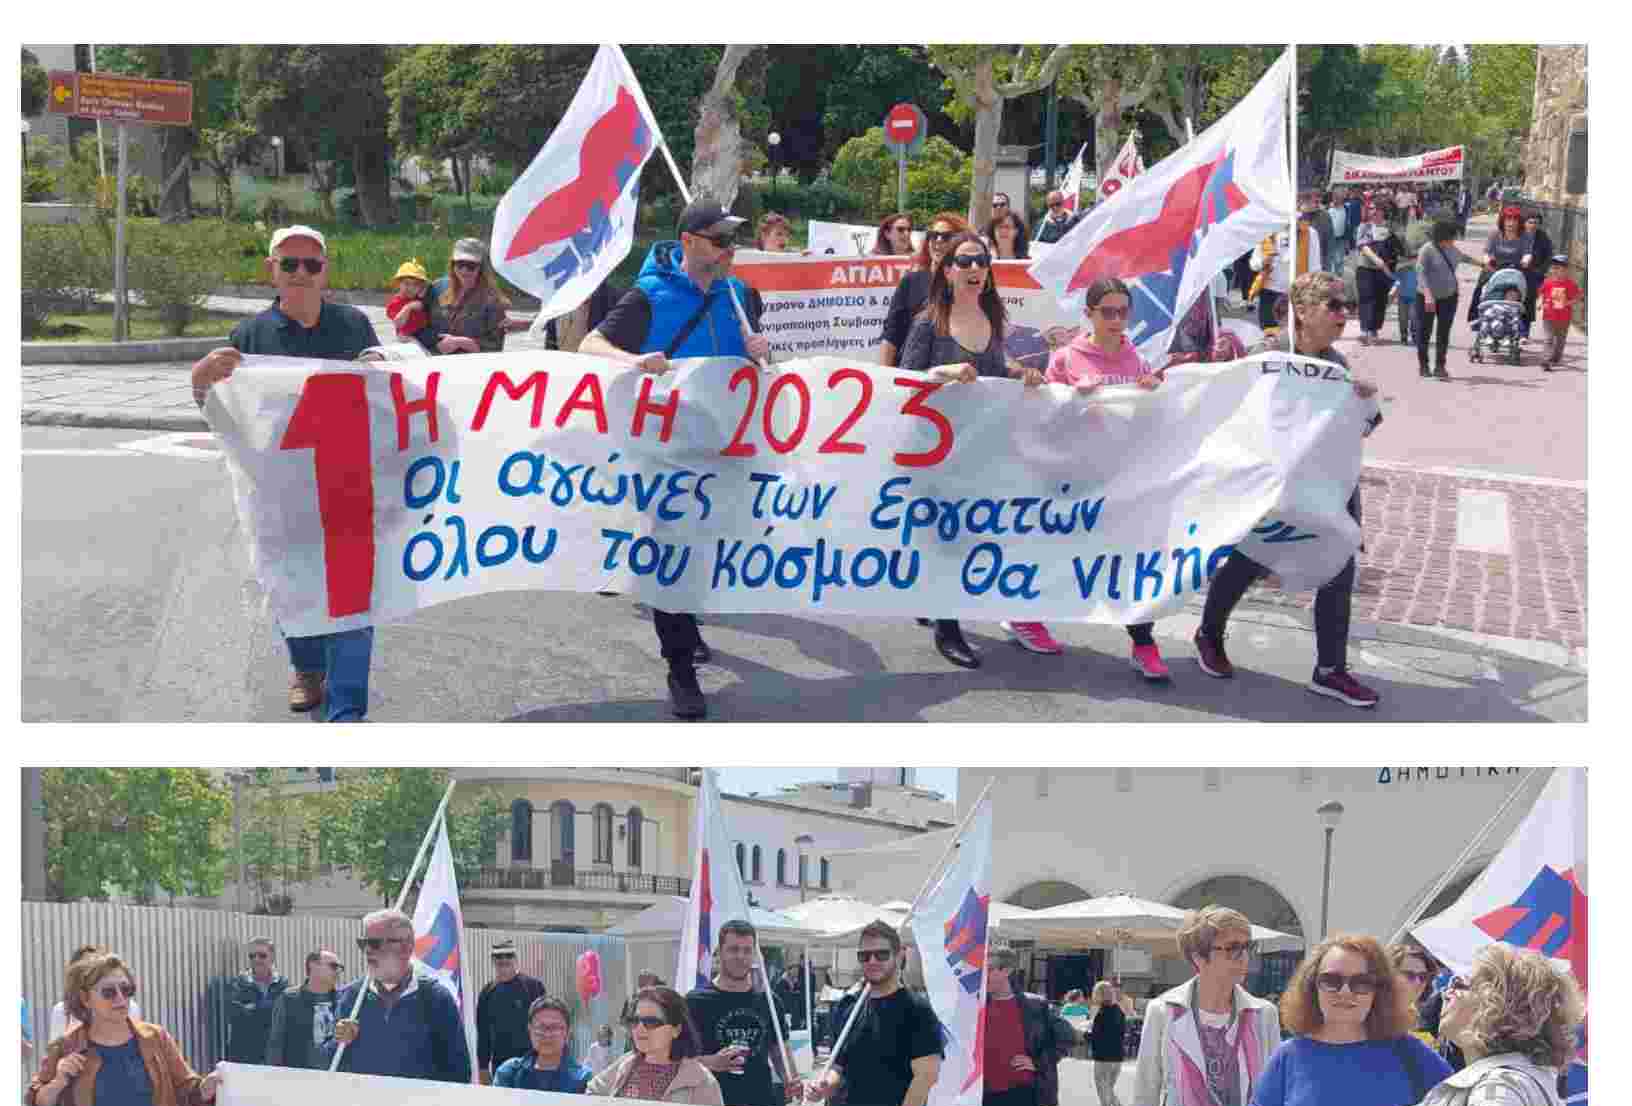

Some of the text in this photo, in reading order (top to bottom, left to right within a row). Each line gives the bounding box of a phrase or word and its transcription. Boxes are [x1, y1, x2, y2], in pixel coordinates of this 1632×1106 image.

[470, 370, 681, 442] ΜΑΗ
[720, 365, 955, 468] 2023
[497, 448, 713, 521] αγώνες
[749, 470, 836, 519] των
[402, 513, 558, 582] όλου
[600, 528, 692, 588] του
[713, 524, 921, 604] κόσμου
